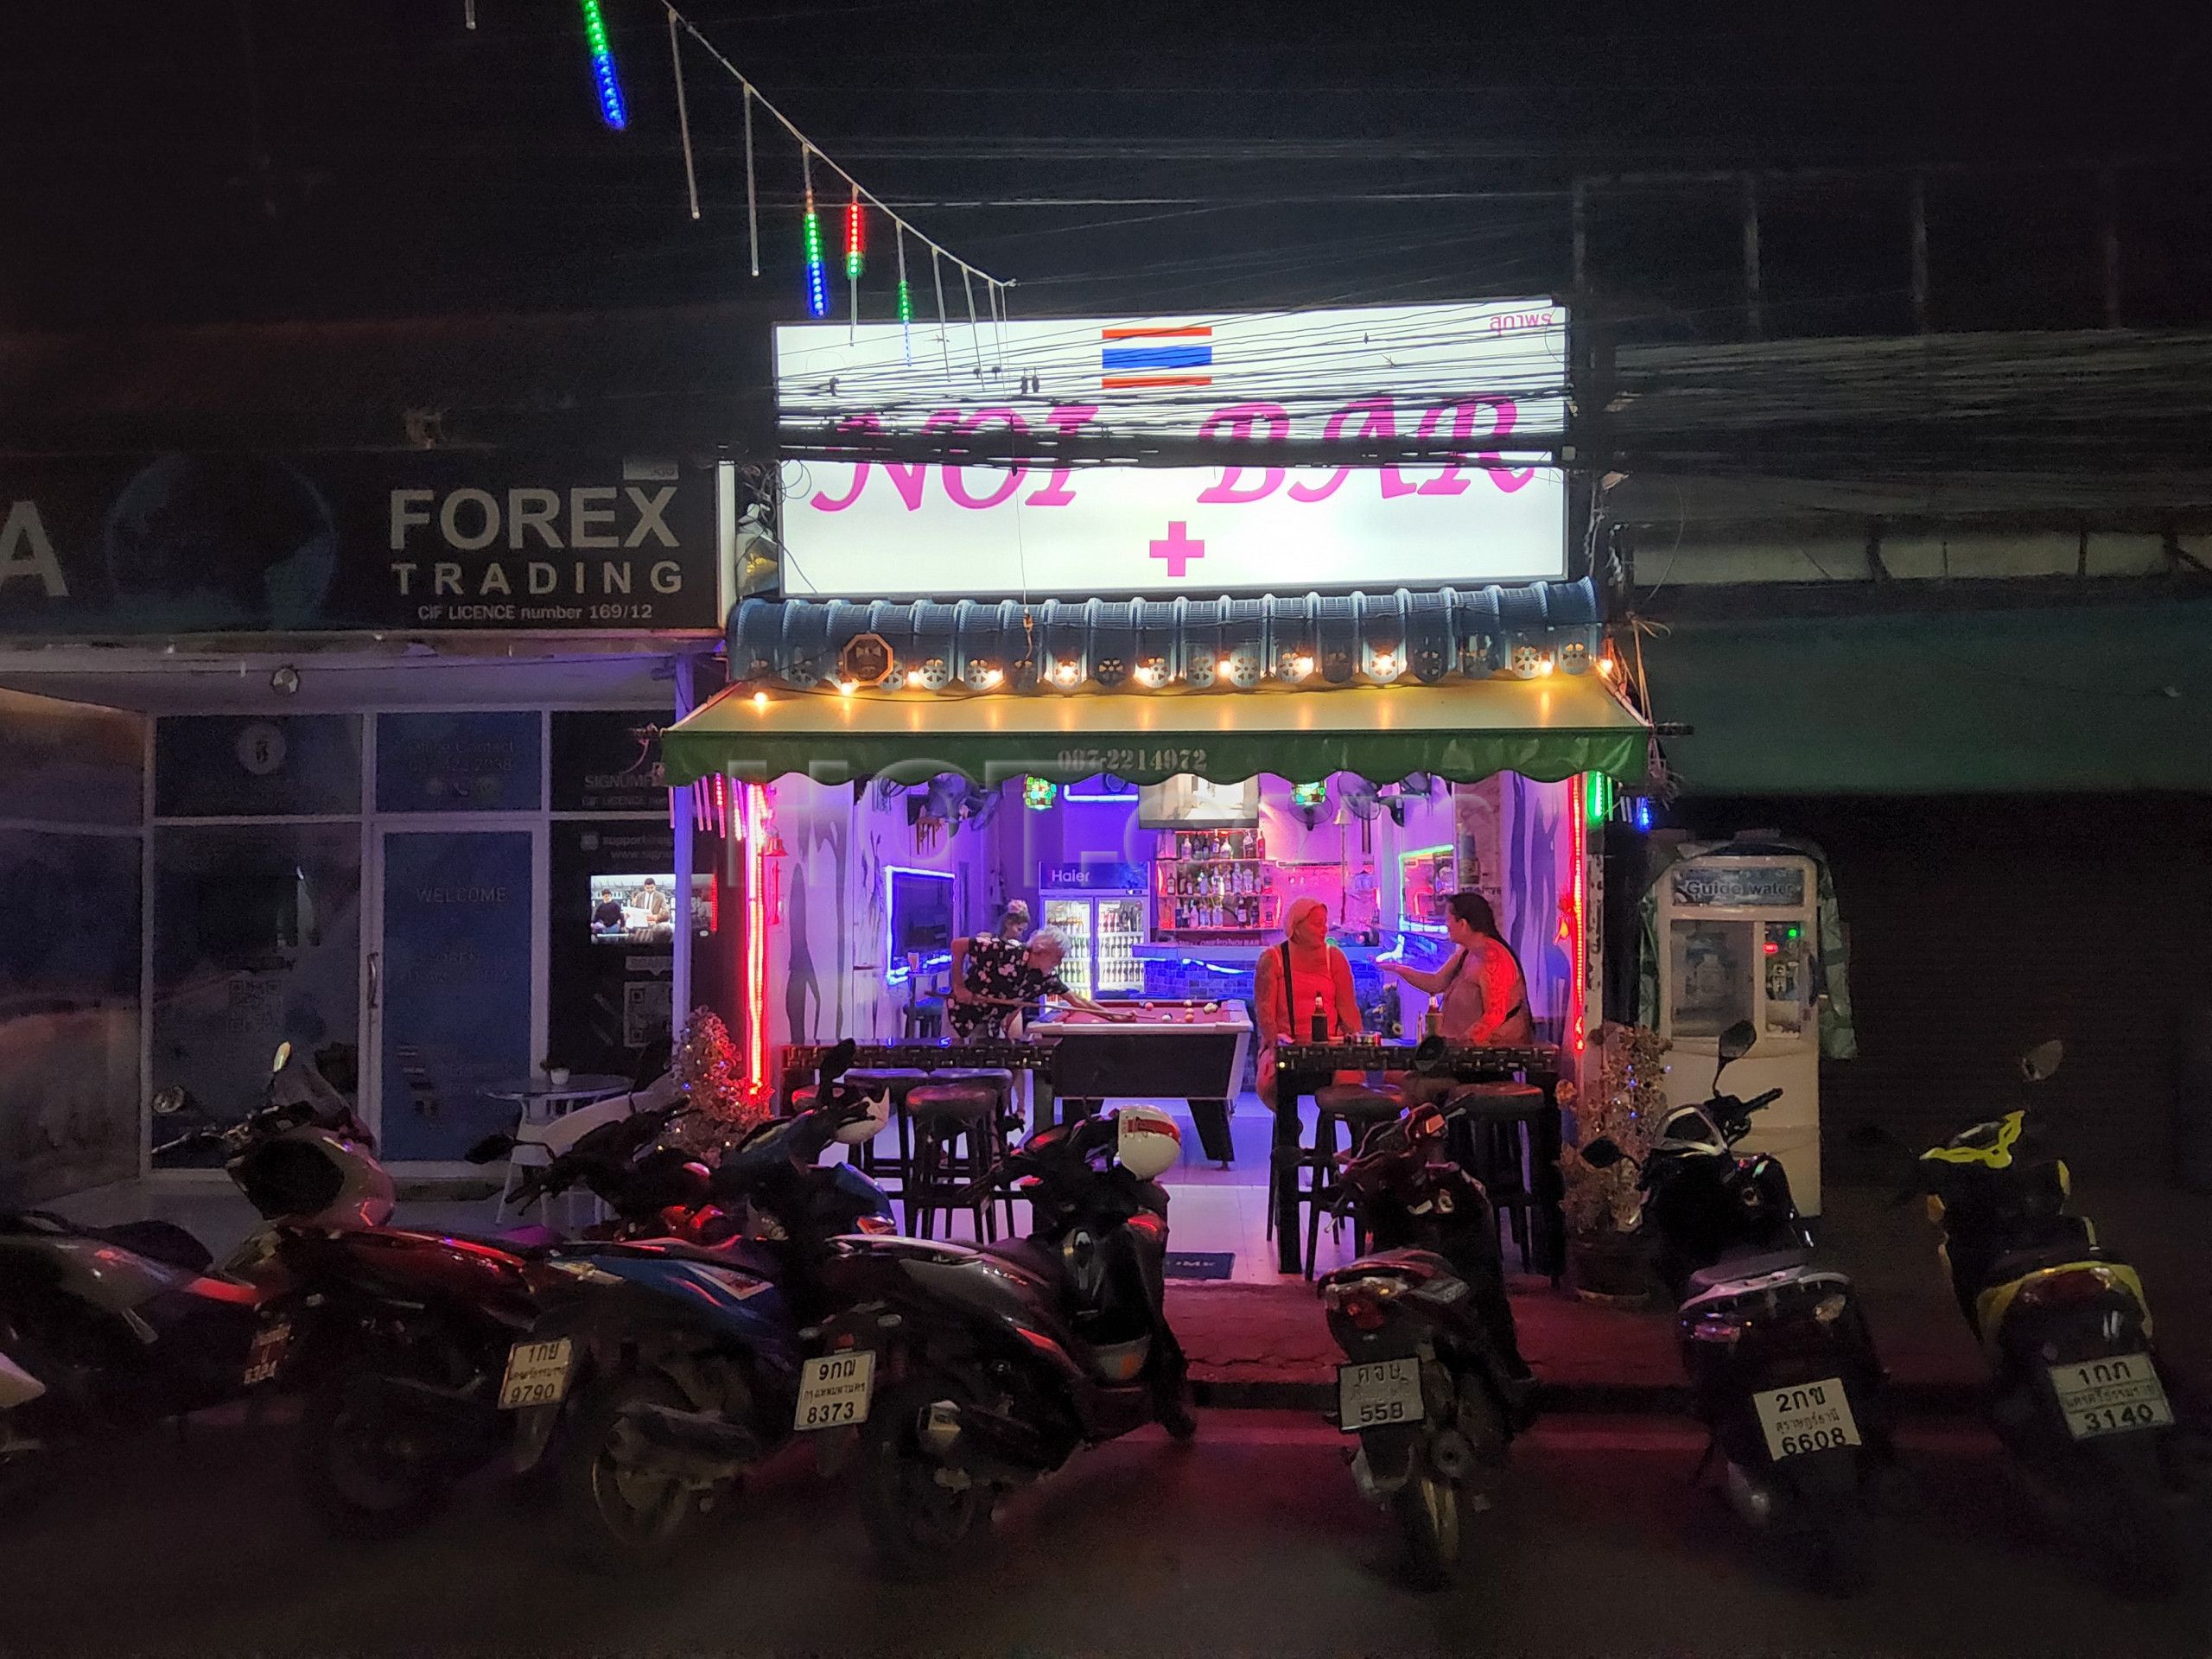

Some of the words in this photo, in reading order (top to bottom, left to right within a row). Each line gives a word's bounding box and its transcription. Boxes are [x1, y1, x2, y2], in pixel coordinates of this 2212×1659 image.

[1196, 393, 1535, 504] BAR
[391, 486, 681, 550] FOREX
[391, 561, 683, 596] TRADING
[418, 606, 444, 620] CIF
[448, 605, 516, 620] LICENCE
[520, 606, 582, 620] number
[589, 605, 653, 620] 169/12
[1051, 868, 1090, 882] Haier
[1687, 880, 1744, 895] Guide
[806, 1402, 855, 1424] 8373
[1361, 1402, 1405, 1423] 558
[2083, 1403, 2155, 1433] 3140
[1782, 1427, 1846, 1457] 6608
